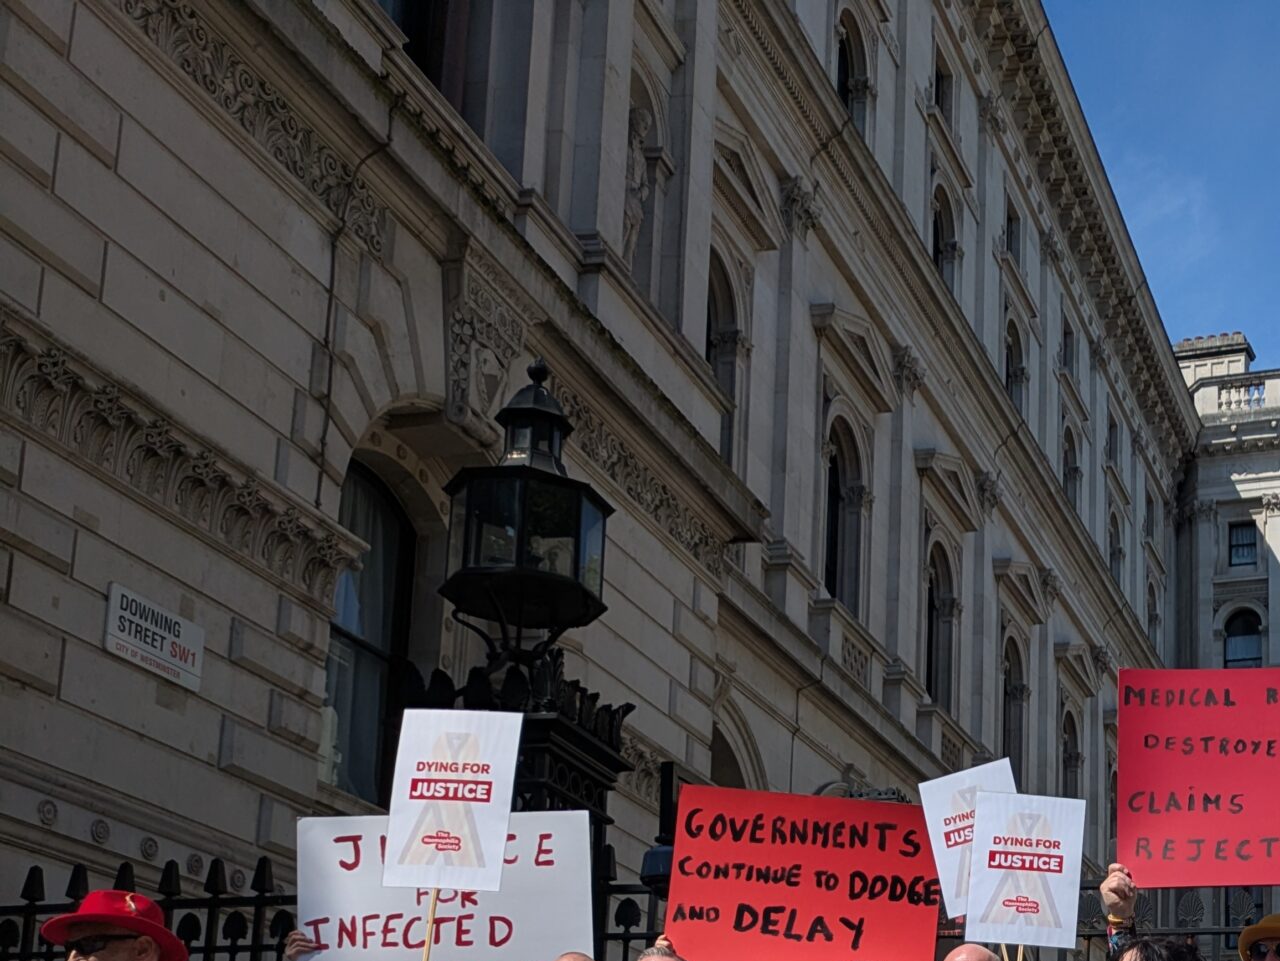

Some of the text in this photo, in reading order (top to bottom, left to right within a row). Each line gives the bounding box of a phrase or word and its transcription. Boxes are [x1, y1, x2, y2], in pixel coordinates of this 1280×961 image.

[120, 593, 181, 639] DOWNING
[115, 642, 129, 656] CITY
[118, 615, 196, 668] STREET SW1
[1124, 685, 1236, 708] MEDICAL
[416, 761, 491, 775] DYING FOR
[412, 782, 489, 799] JUSTICE
[684, 808, 921, 858] GOVERNMENTS
[993, 836, 1061, 850] DYING FOR
[990, 853, 1061, 870] JUSTICE
[678, 856, 941, 906] CONTINUE TO DODGE
[304, 913, 513, 950] INFECTED
[672, 903, 865, 951] AND DELAY
